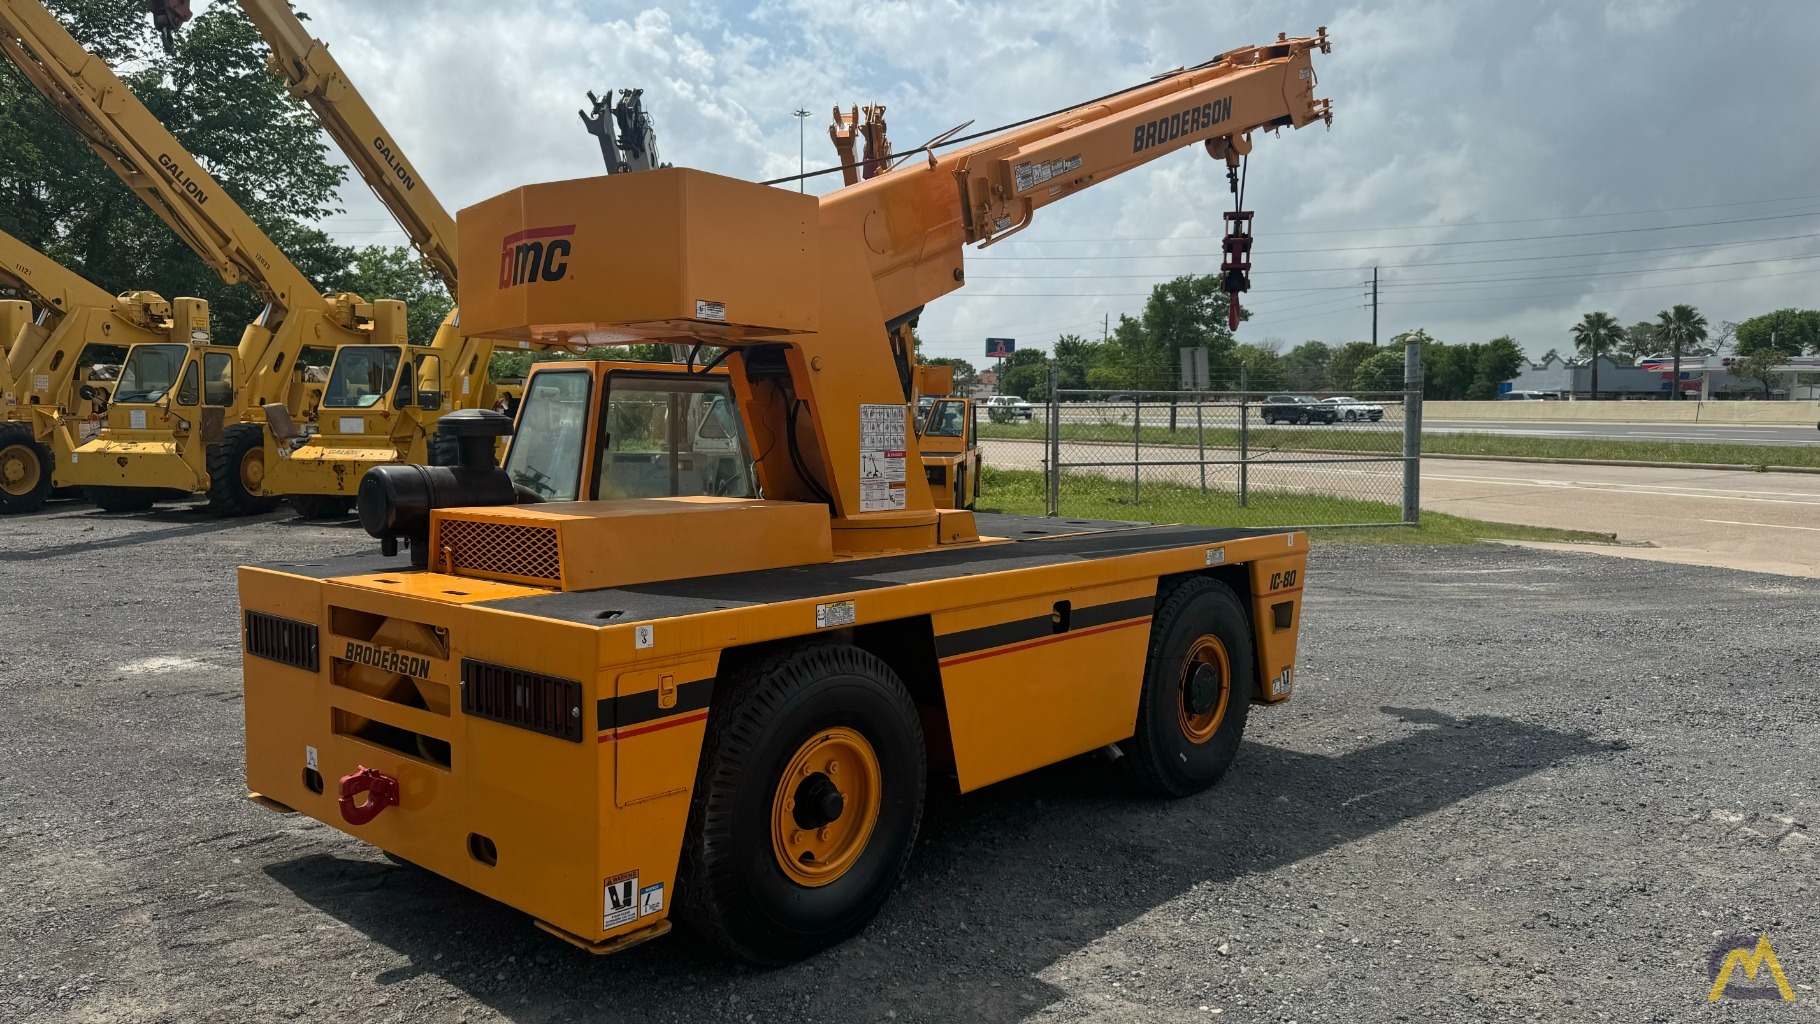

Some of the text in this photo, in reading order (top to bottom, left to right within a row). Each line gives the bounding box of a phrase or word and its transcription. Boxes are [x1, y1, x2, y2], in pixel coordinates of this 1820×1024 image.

[1133, 96, 1233, 154] BRODERSON
[158, 153, 208, 205] GALION
[373, 136, 415, 191] GALION
[15, 263, 32, 277] 11121
[255, 252, 271, 271] 12022
[1269, 569, 1297, 591] IC-80
[345, 641, 431, 680] BRODERSON
